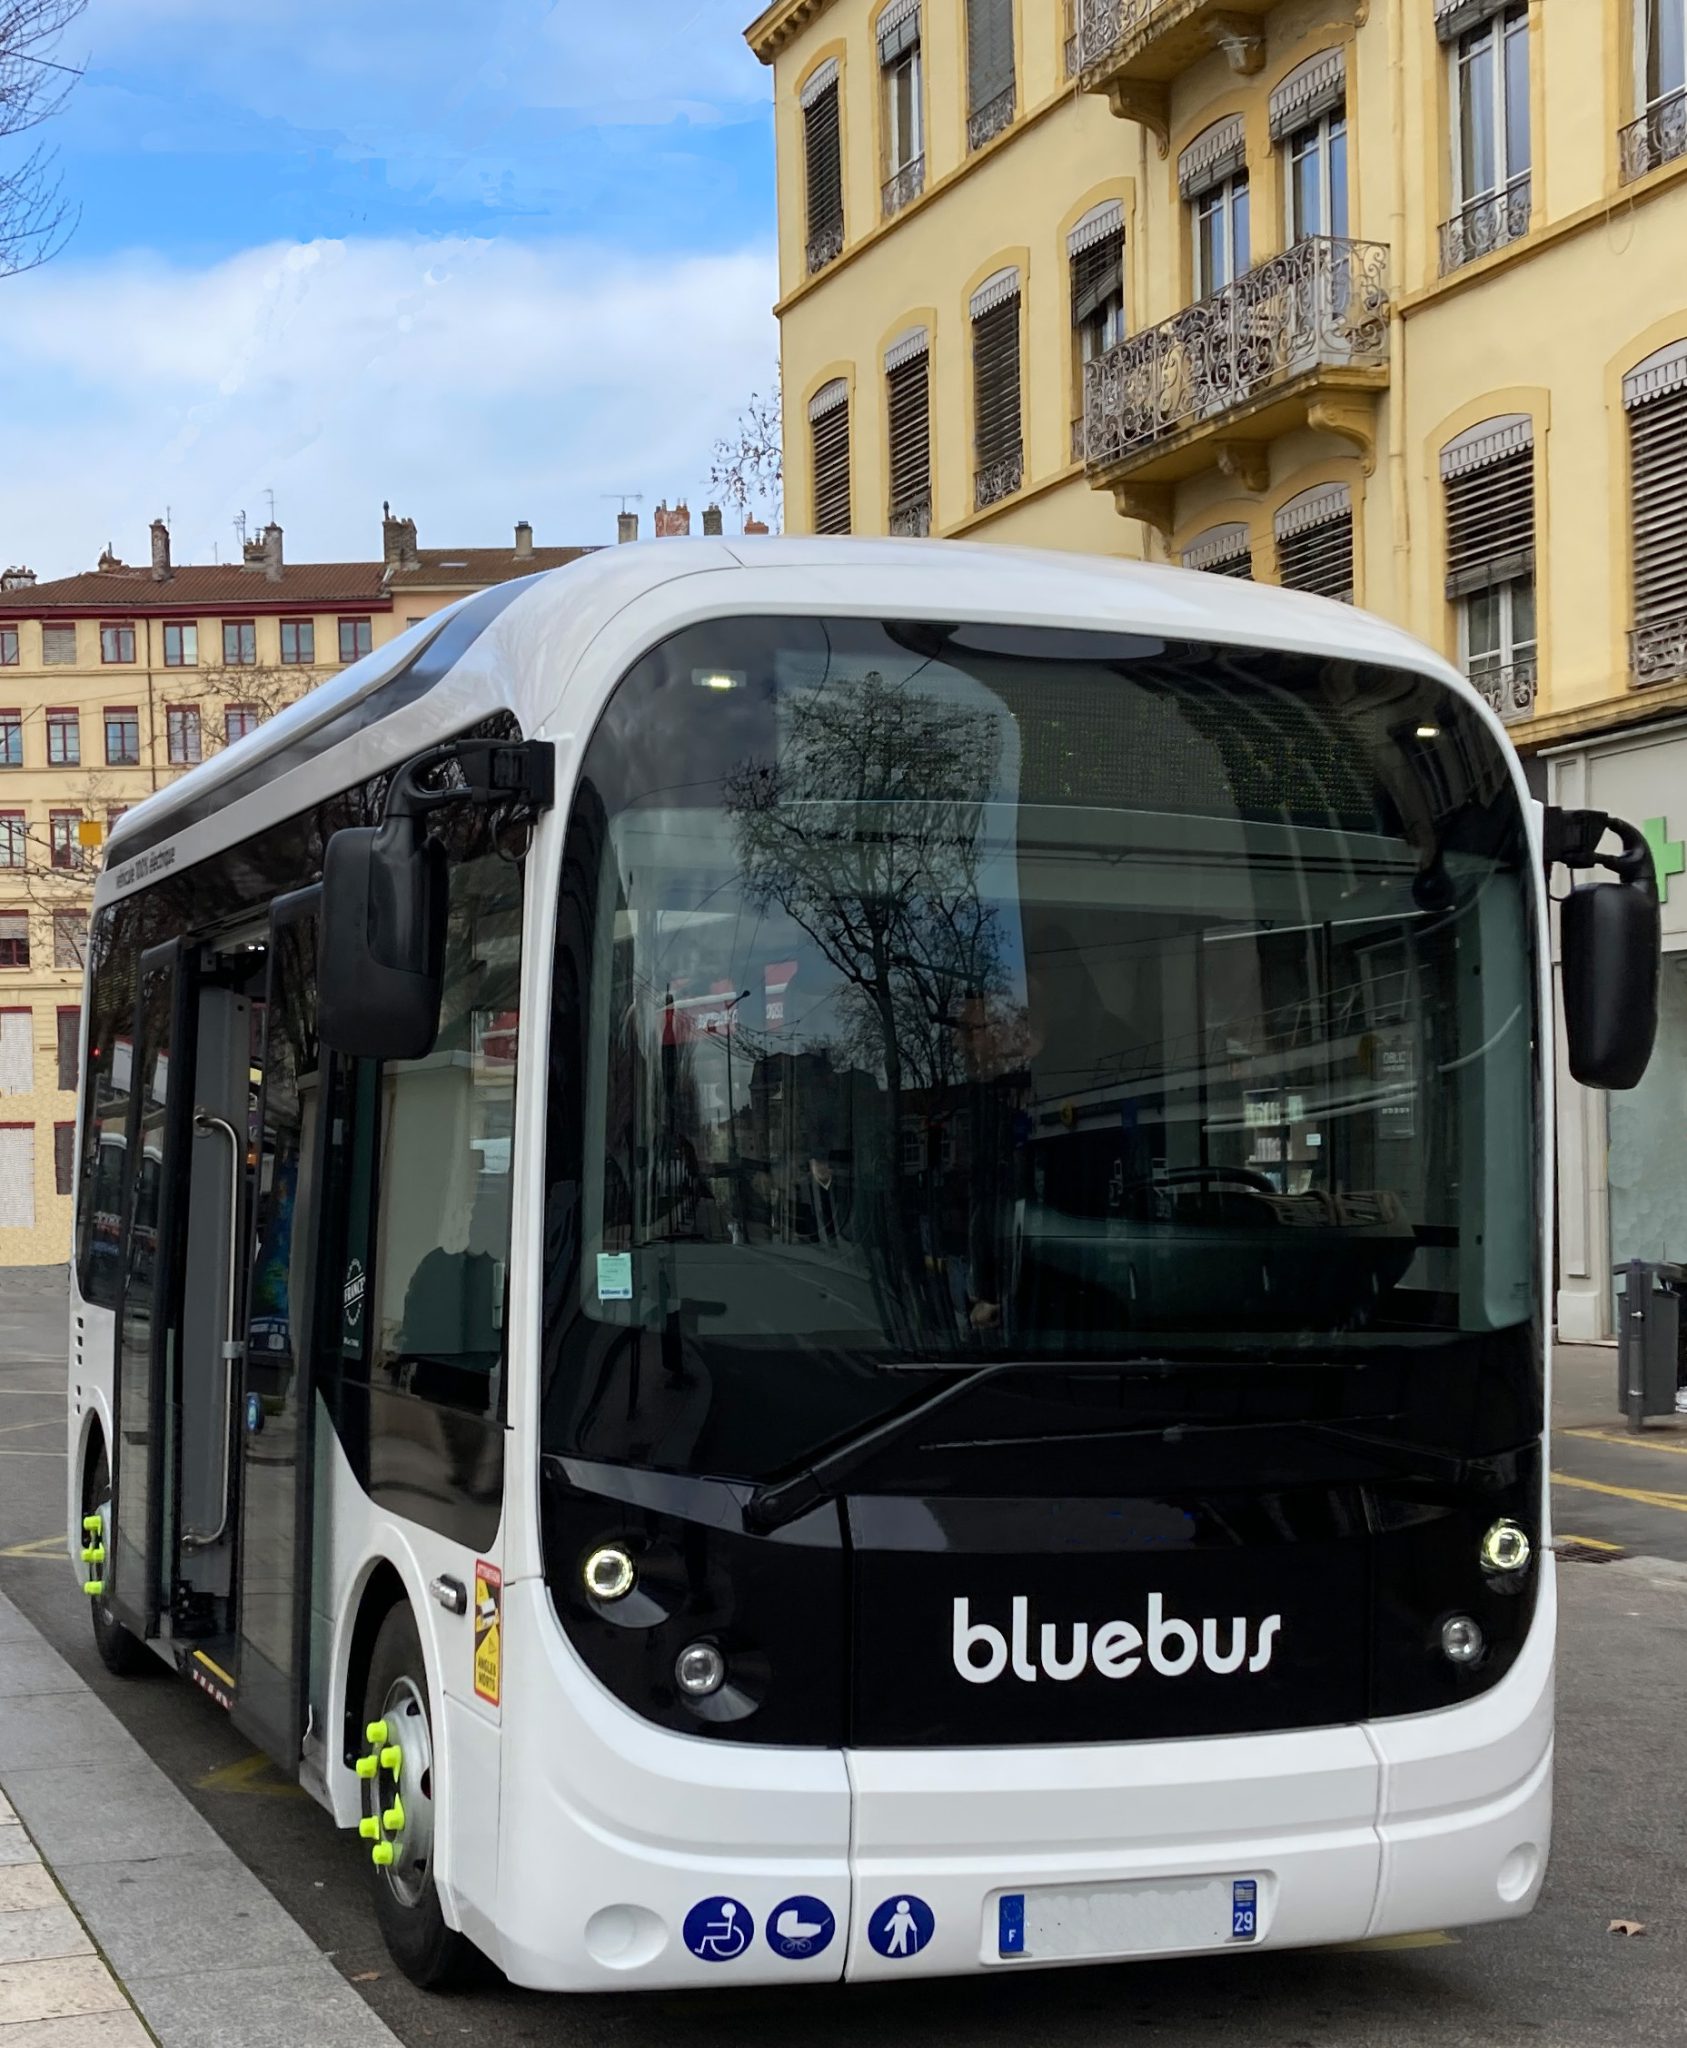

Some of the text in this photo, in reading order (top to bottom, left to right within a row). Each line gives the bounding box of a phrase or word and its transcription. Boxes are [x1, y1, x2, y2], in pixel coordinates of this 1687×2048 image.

[344, 1276, 366, 1303] FRANCE
[953, 1592, 1281, 1683] bluebus
[1234, 1911, 1254, 1931] 29
[1008, 1929, 1017, 1943] F
